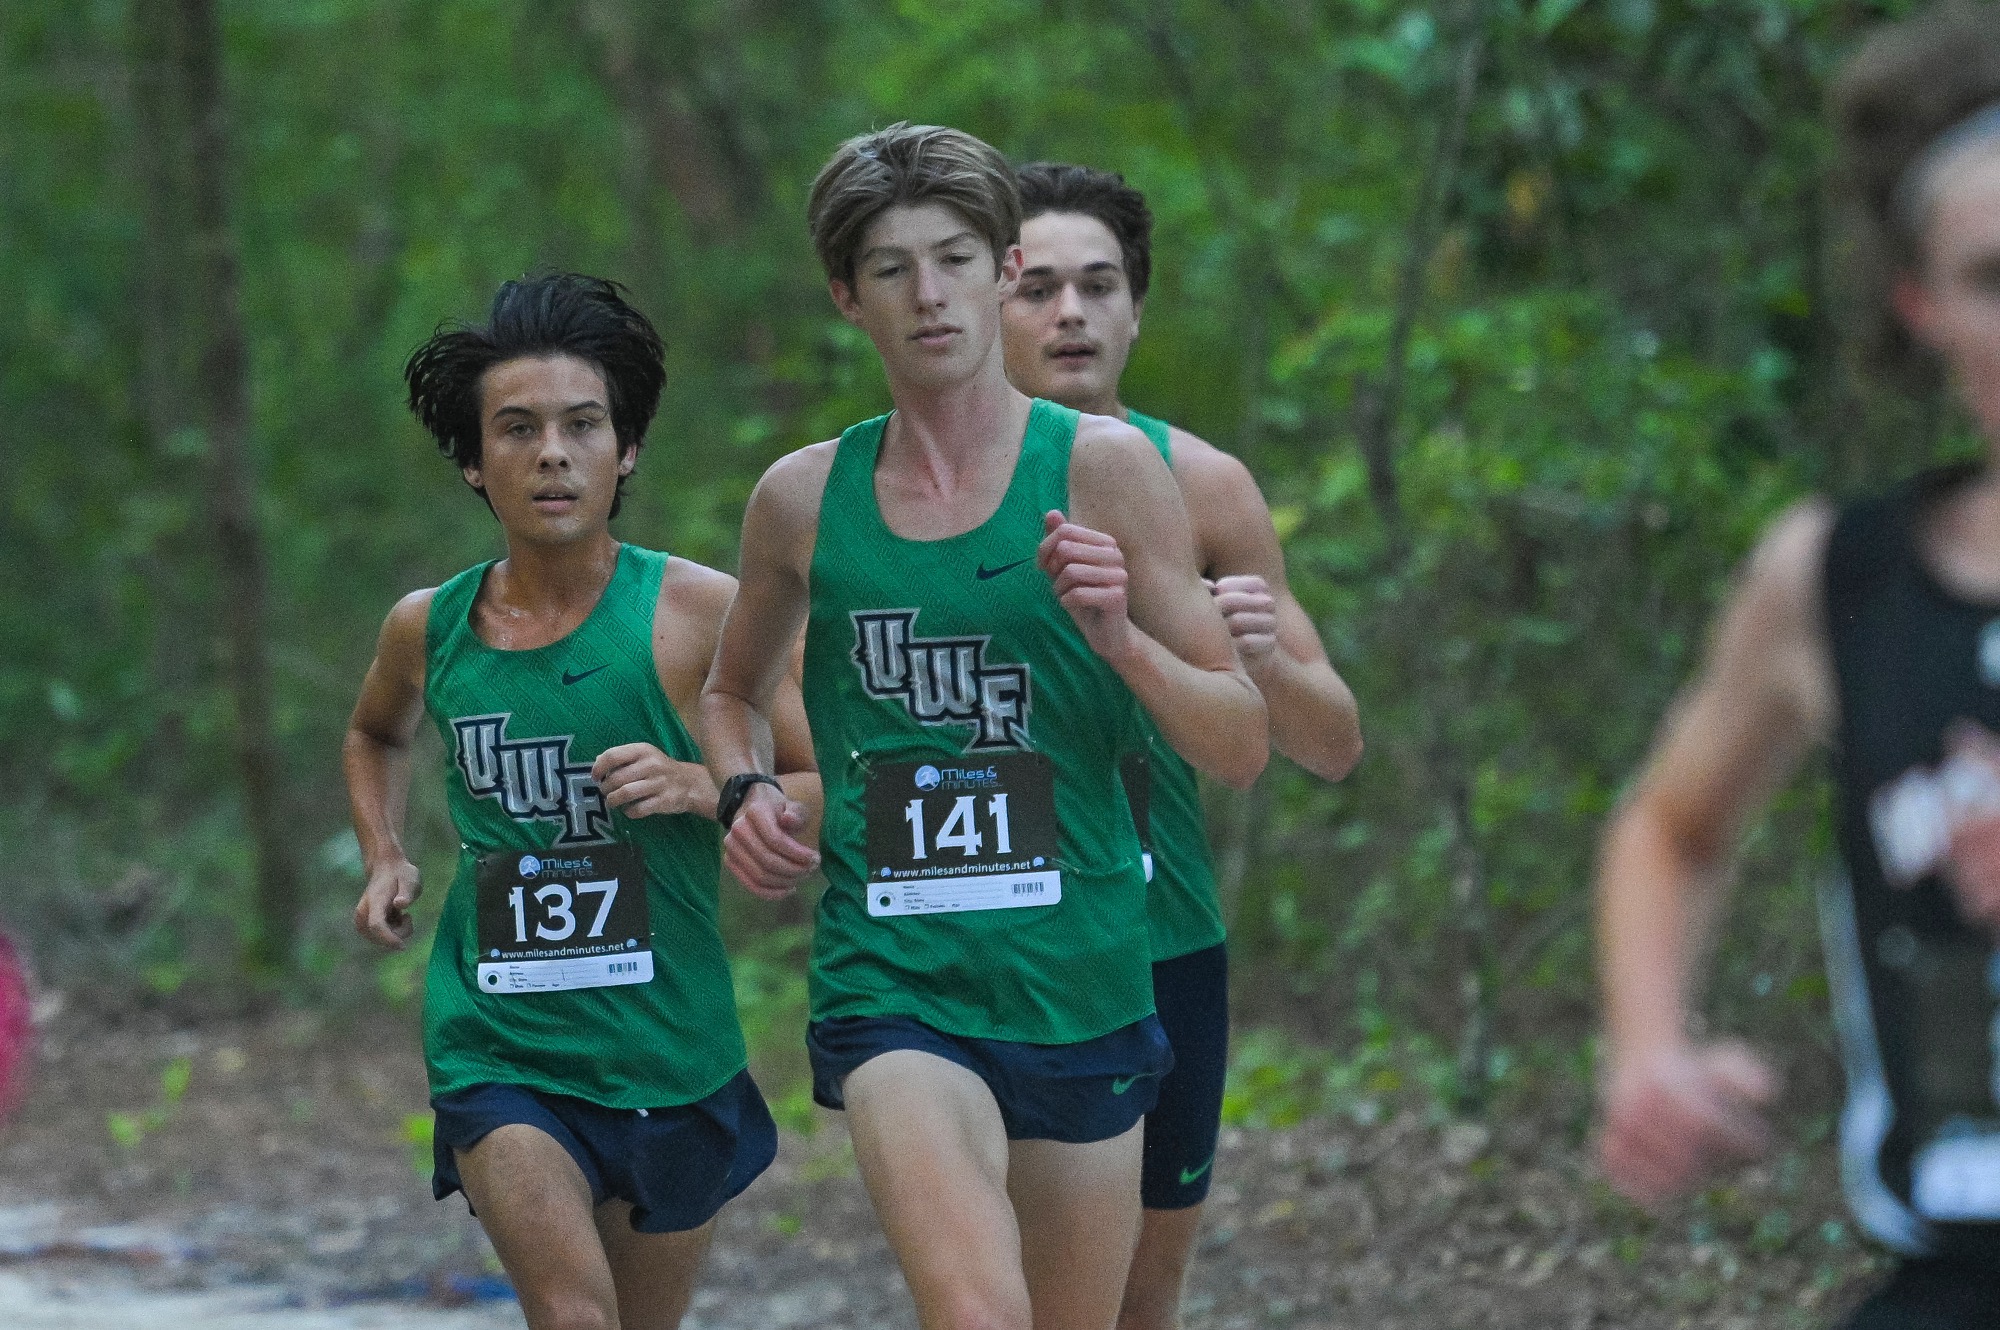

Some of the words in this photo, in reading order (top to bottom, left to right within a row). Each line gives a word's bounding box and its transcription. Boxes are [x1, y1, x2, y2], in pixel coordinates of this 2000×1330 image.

[850, 607, 1032, 754] UWF
[450, 713, 616, 849] UWF
[986, 766, 998, 779] &
[905, 793, 1012, 860] 141
[582, 856, 593, 868] &
[893, 860, 1031, 879] www.milesandminutes.net
[509, 878, 619, 942] 137
[501, 943, 625, 960] www.milesandminutes.net
